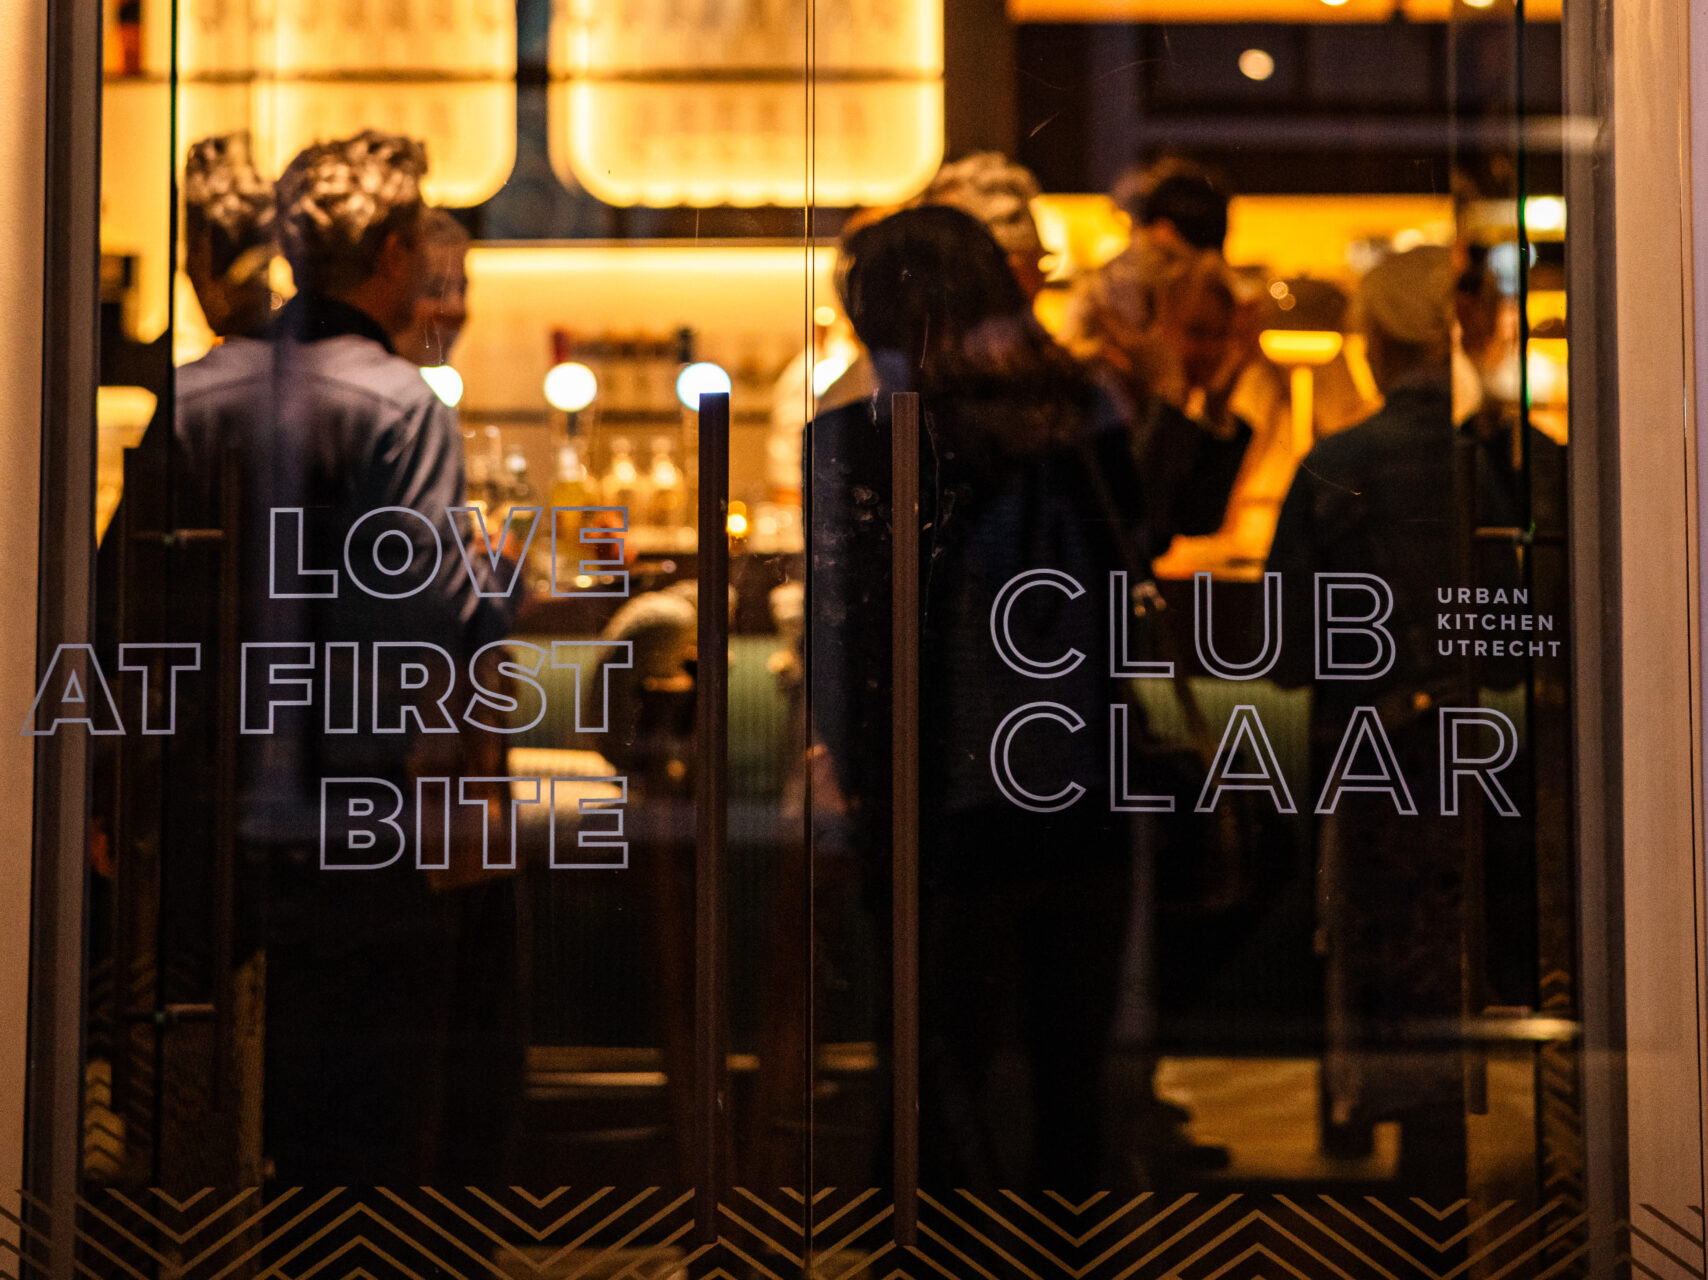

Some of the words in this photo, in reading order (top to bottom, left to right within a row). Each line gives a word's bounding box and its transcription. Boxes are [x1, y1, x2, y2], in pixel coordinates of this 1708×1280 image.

[269, 506, 630, 600] LOVE
[1437, 587, 1528, 604] URBAN
[990, 568, 1396, 681] CLUB
[1437, 614, 1553, 631] KITCHEN
[1438, 639, 1560, 657] UTRECHT
[21, 643, 201, 736] AT
[240, 640, 634, 734] FIRST
[990, 701, 1522, 817] CLAAR
[320, 777, 629, 871] BITE
